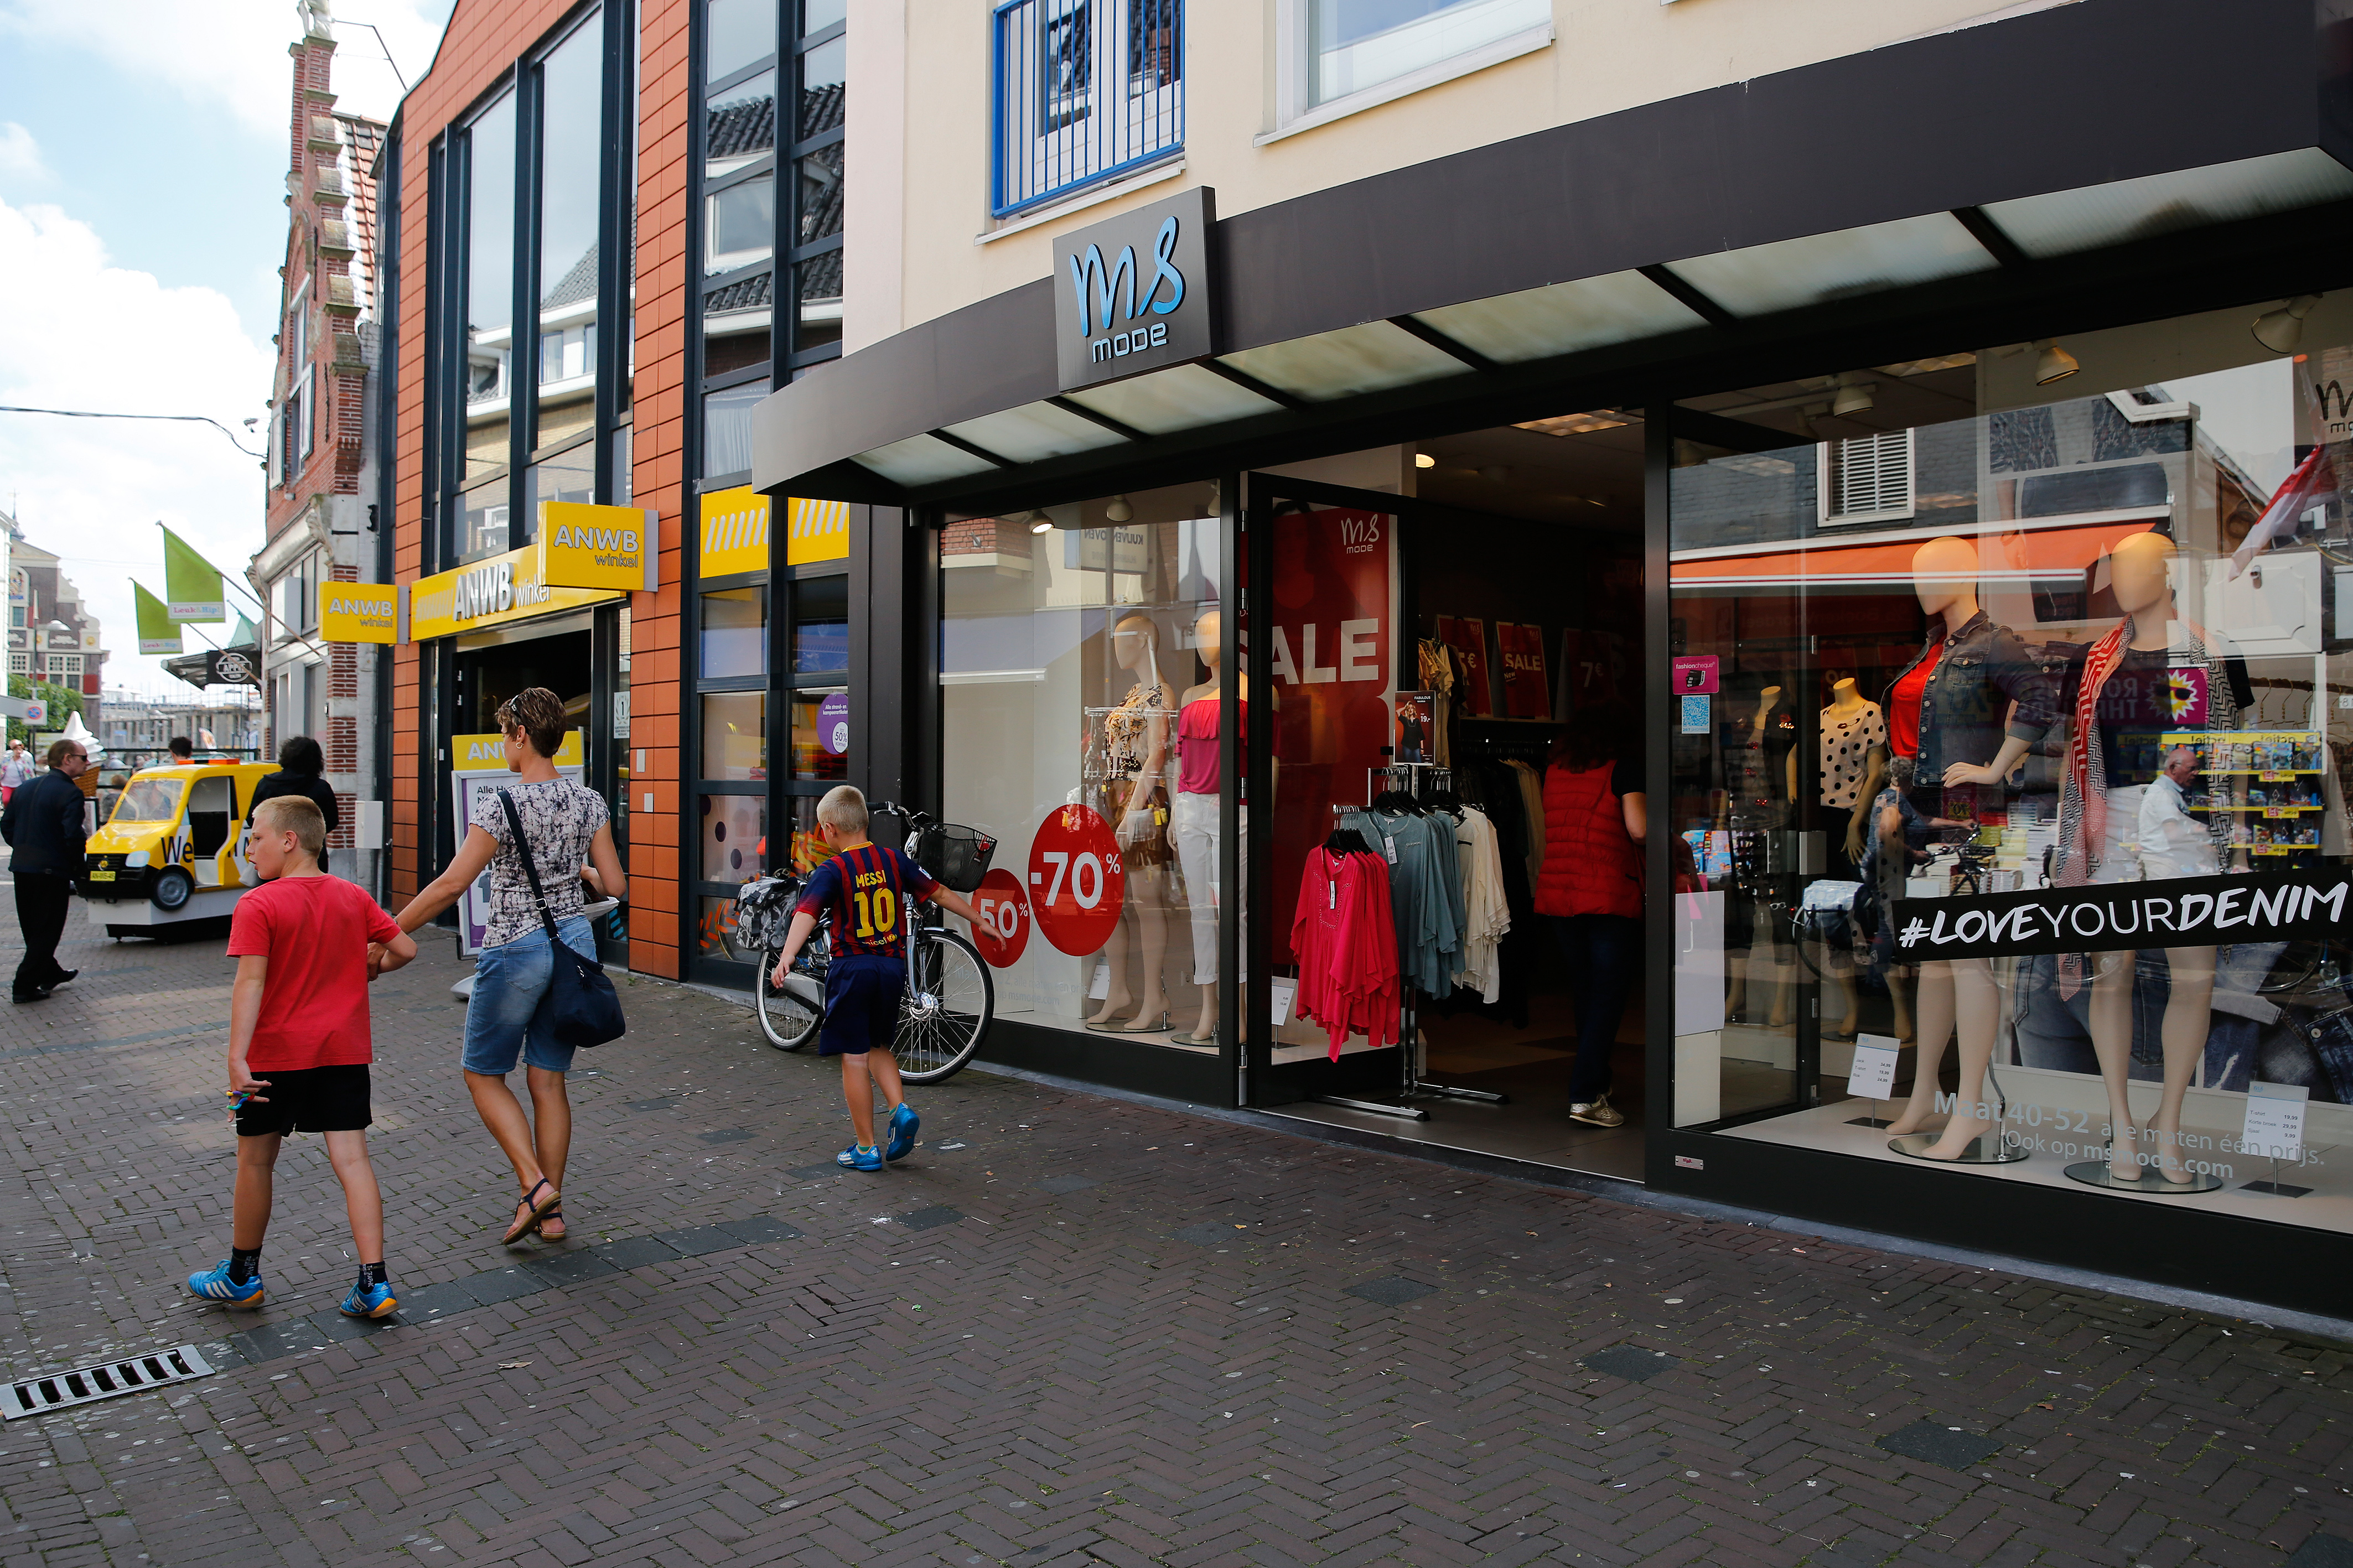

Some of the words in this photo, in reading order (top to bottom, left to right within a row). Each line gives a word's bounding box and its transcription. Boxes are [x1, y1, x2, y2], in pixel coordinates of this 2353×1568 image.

[553, 525, 639, 553] ANWB
[594, 553, 639, 568] winkel
[453, 562, 514, 621] ANWB
[516, 579, 550, 608] winkel
[328, 598, 393, 617] ANWB
[360, 617, 393, 628] winkel
[1272, 617, 1379, 685] ALE
[1505, 653, 1541, 671] SALE
[835, 732, 848, 743] 50%
[477, 786, 494, 794] Alle
[856, 870, 887, 888] MESSI
[1030, 852, 1121, 909] -70%
[854, 887, 895, 938] 10
[1934, 1090, 2003, 1123] Maat
[2007, 1102, 2090, 1134] 40-52
[2100, 1120, 2137, 1141] alle
[2143, 1128, 2212, 1151] maten
[2220, 1134, 2261, 1156] één
[2006, 1130, 2046, 1152] Ook
[2050, 1140, 2077, 1160] op
[2083, 1144, 2233, 1179] msmode.com
